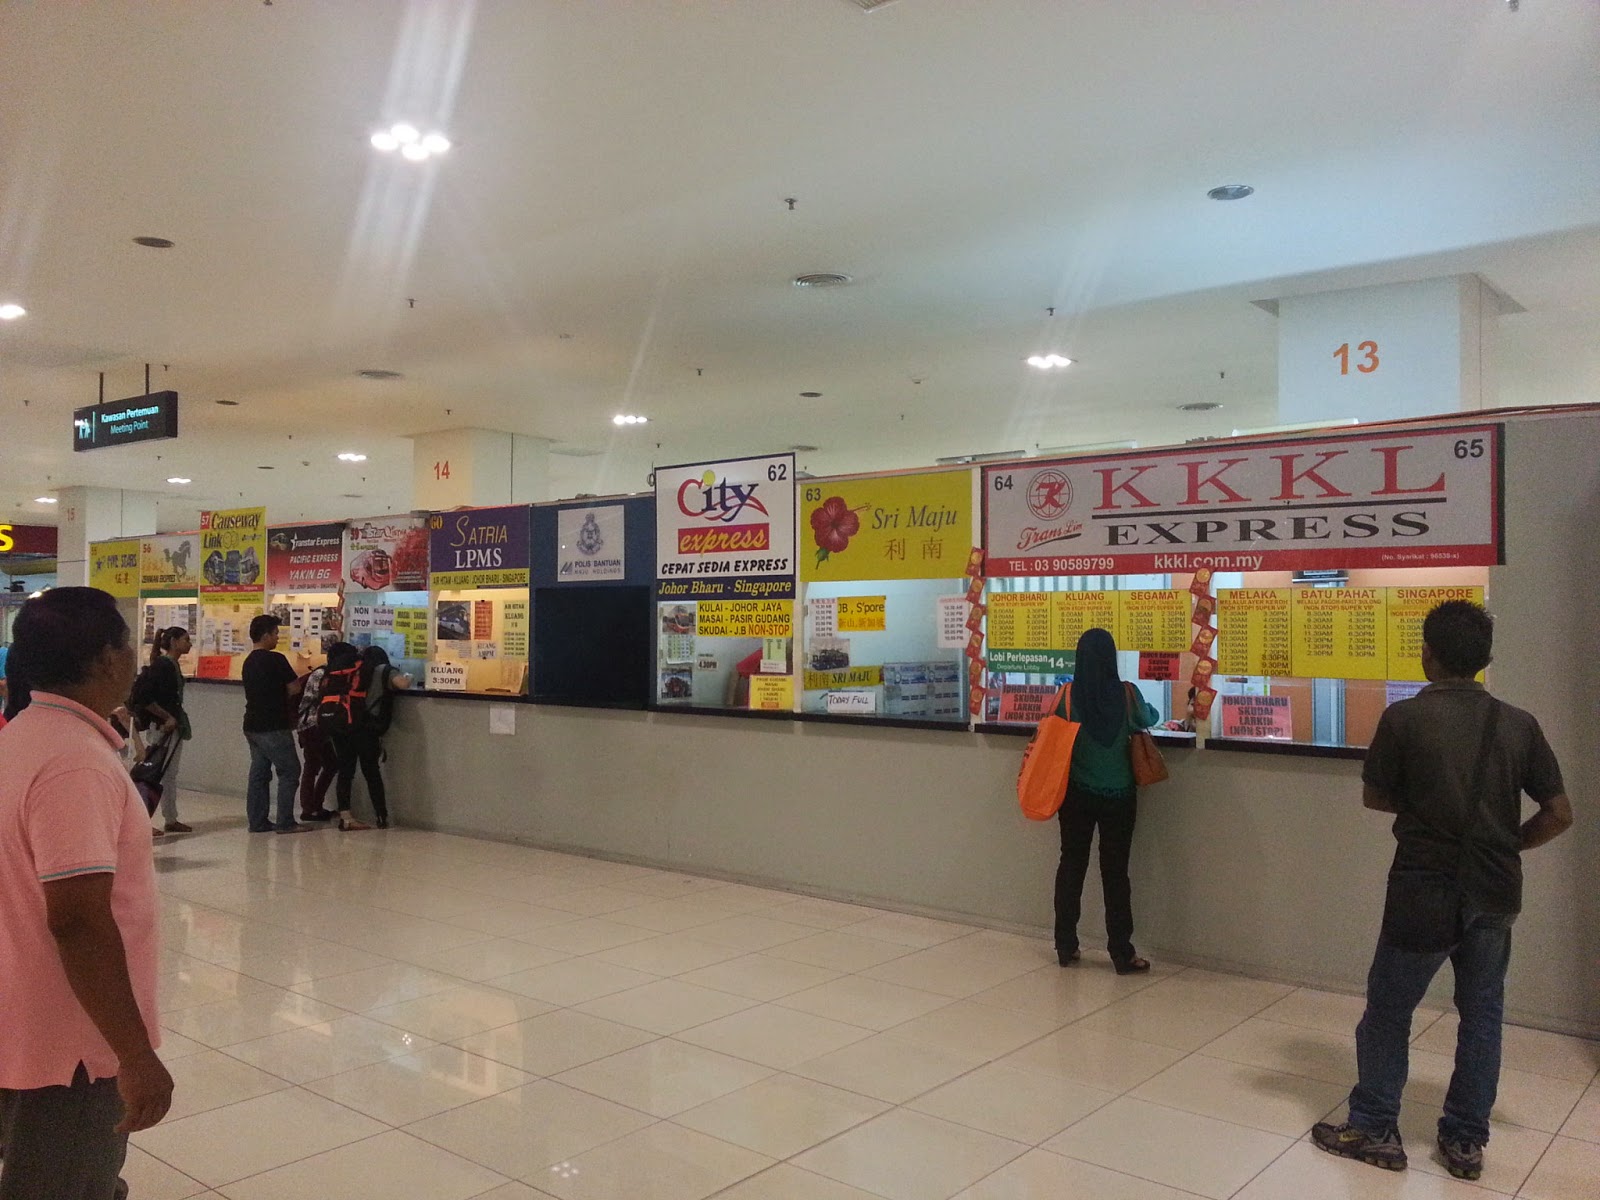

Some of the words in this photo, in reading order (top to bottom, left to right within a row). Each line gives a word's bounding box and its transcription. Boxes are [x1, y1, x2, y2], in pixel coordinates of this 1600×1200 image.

[1333, 341, 1380, 375] 13
[101, 413, 126, 423] Kawasan
[126, 406, 159, 418] Pertemuan
[110, 423, 133, 435] Meeting
[133, 420, 149, 431] Point
[1454, 439, 1484, 459] 65
[434, 461, 450, 480] 14
[768, 464, 787, 481] 62
[994, 475, 1013, 491] 64
[1093, 446, 1445, 510] KKKL
[677, 470, 760, 522] City
[806, 488, 821, 501] 63
[201, 515, 209, 526] 57
[211, 512, 262, 531] Causeway
[431, 516, 443, 529] 60
[872, 507, 900, 529] Sri
[906, 505, 958, 532] Maju
[450, 515, 508, 547] SATRIA
[1104, 511, 1430, 546] EXPRESS
[204, 533, 222, 548] Link
[315, 536, 340, 548] Express
[680, 528, 767, 557] express
[143, 544, 151, 553] 56
[290, 554, 311, 563] PACIFIC
[311, 553, 338, 562] EXPRESS
[455, 548, 502, 568] LPMS
[574, 560, 591, 568] POLIS
[594, 559, 621, 567] BANTUAN
[1009, 561, 1027, 572] TEL
[1034, 559, 1049, 570] 03
[1053, 557, 1115, 570] 90589799
[1154, 554, 1263, 570] kkkl.com.my
[662, 563, 695, 575] CEPAT
[697, 561, 730, 573] SEDIA
[734, 559, 788, 572] EXPRESS
[289, 570, 314, 580] YAKIN
[316, 569, 331, 579] BG
[659, 582, 688, 594] Johor
[690, 581, 723, 594] Bharu
[734, 580, 791, 596] Singapore
[1229, 590, 1277, 599] MELAKA
[1301, 590, 1332, 599] BATU
[1337, 589, 1376, 598] PAHAT
[1397, 588, 1473, 599] SINGAPORE
[991, 594, 1018, 602] JOHOR
[1020, 593, 1048, 601] BHARU
[1065, 592, 1105, 601] KLUANG
[1130, 591, 1180, 600] SEGAMAT
[700, 604, 723, 612] KULAI
[730, 603, 758, 612] JOHOR
[762, 603, 782, 612] JAYA
[856, 602, 885, 615] S'pore
[700, 615, 723, 623] MASAI
[730, 615, 753, 623] PASIR
[755, 614, 790, 623] GUDANG
[699, 626, 728, 635] SKUDAI
[734, 626, 746, 635] J.B
[748, 625, 790, 635] NON-STOP
[989, 652, 1005, 661] Lobi
[1006, 652, 1048, 664] Perlepasan
[1048, 657, 1065, 668] 14
[431, 666, 464, 674] KLUANG
[831, 672, 847, 683] SRI
[849, 670, 872, 682] MAJU
[432, 677, 461, 685] 3:30PM
[1014, 694, 1043, 702] SKUDAI
[1223, 696, 1252, 705] JOHOR
[1255, 697, 1288, 706] BHARU
[1013, 703, 1042, 711] LARKIN
[1238, 707, 1273, 715] SKUDAI
[1239, 716, 1273, 725] LARKIN
